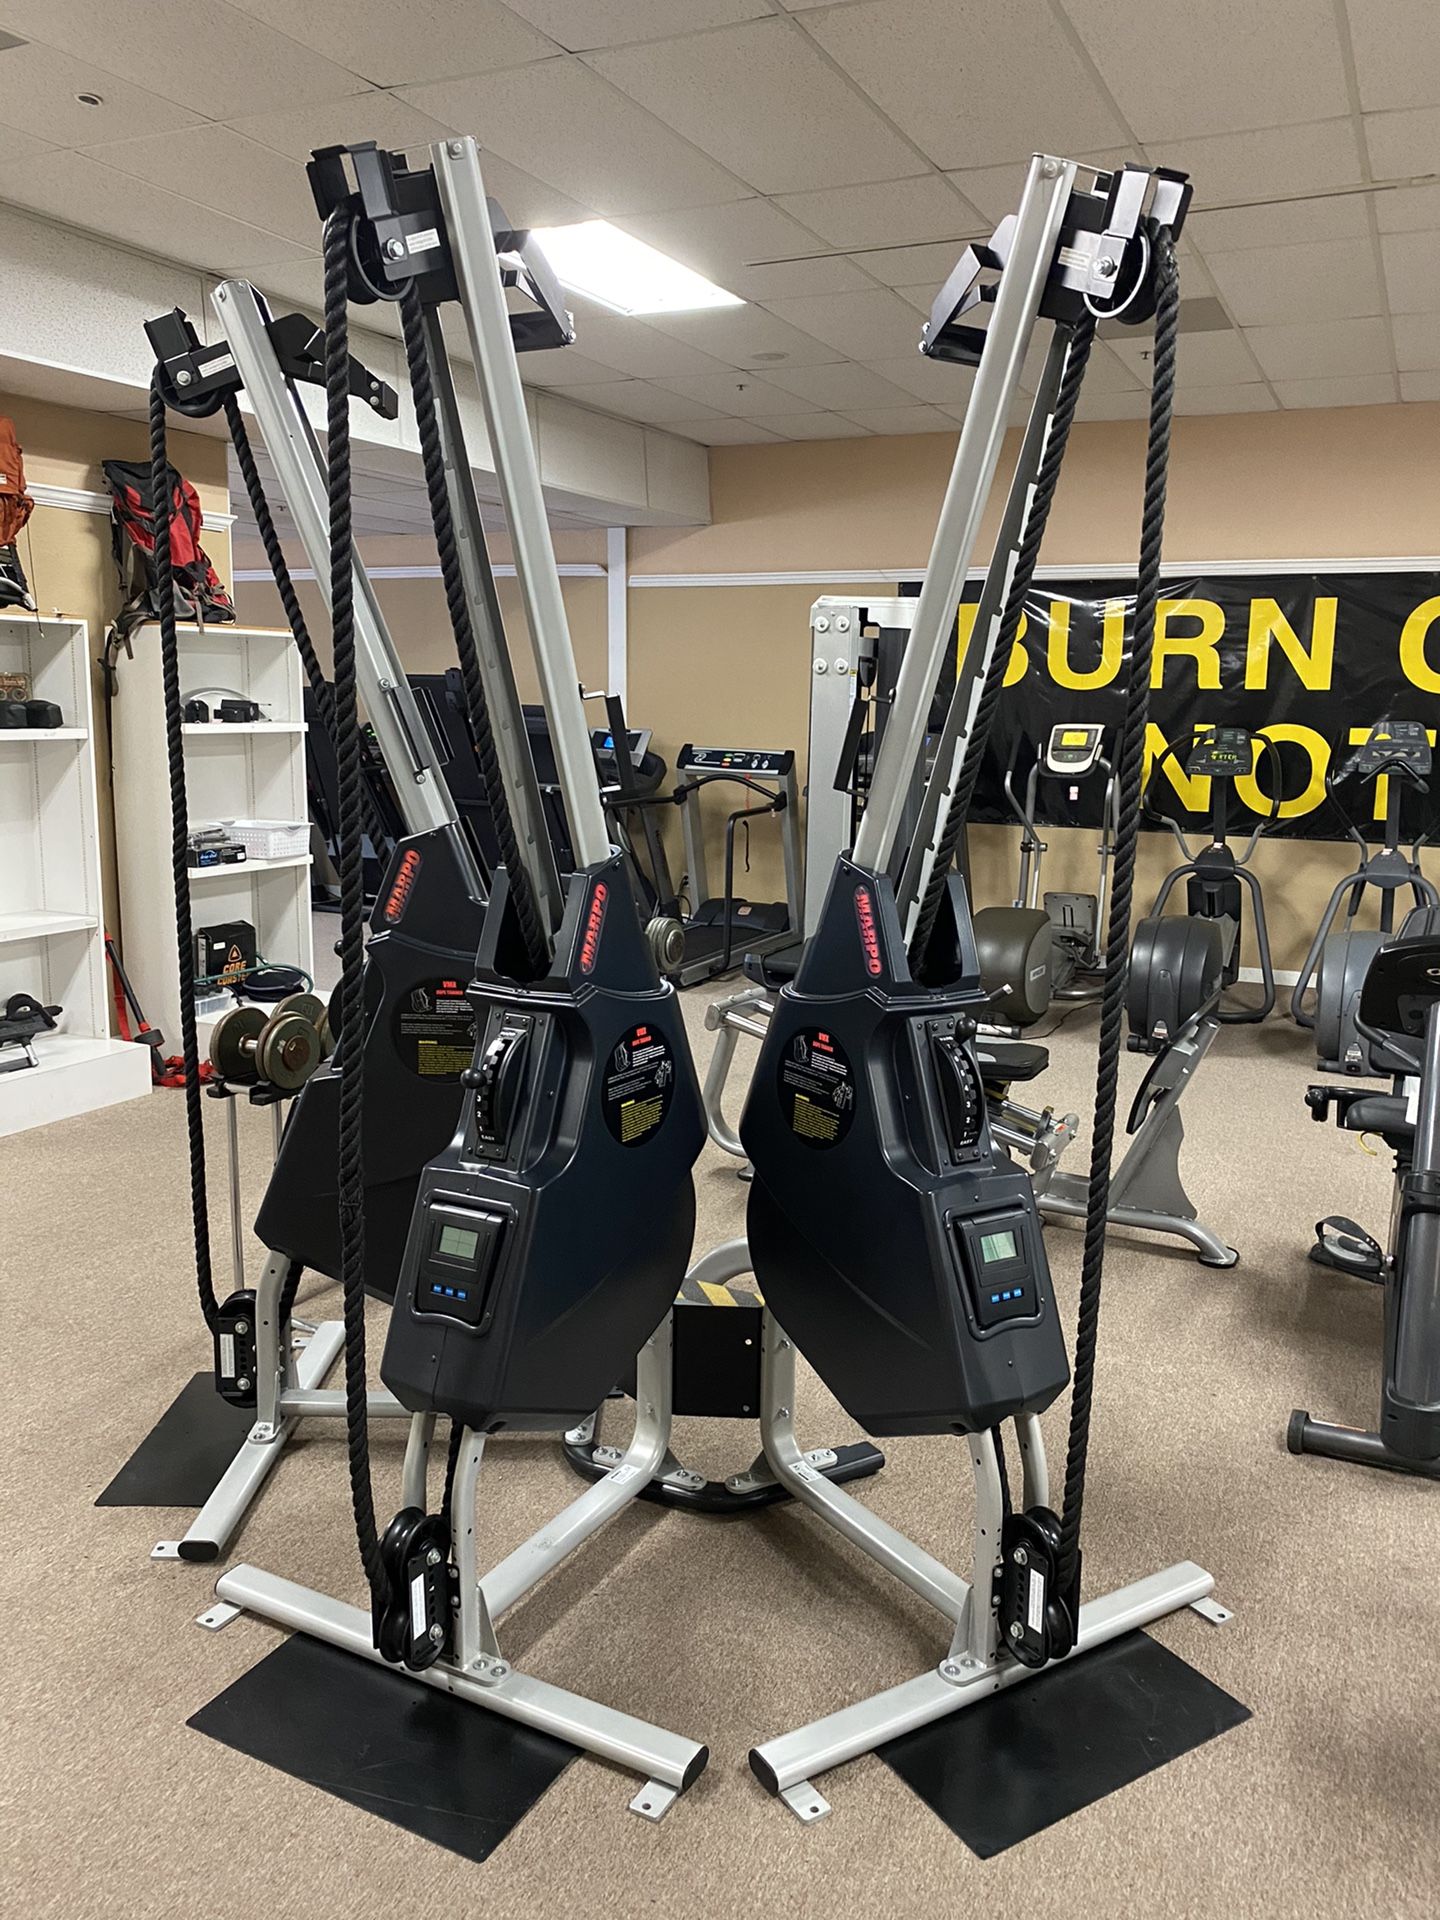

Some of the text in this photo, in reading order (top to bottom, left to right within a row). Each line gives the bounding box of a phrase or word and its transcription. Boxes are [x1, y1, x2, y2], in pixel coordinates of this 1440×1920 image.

[385, 849, 420, 918] MARPO
[581, 883, 607, 967] MARPO
[856, 893, 882, 974] MARPO
[223, 960, 247, 974] CORE
